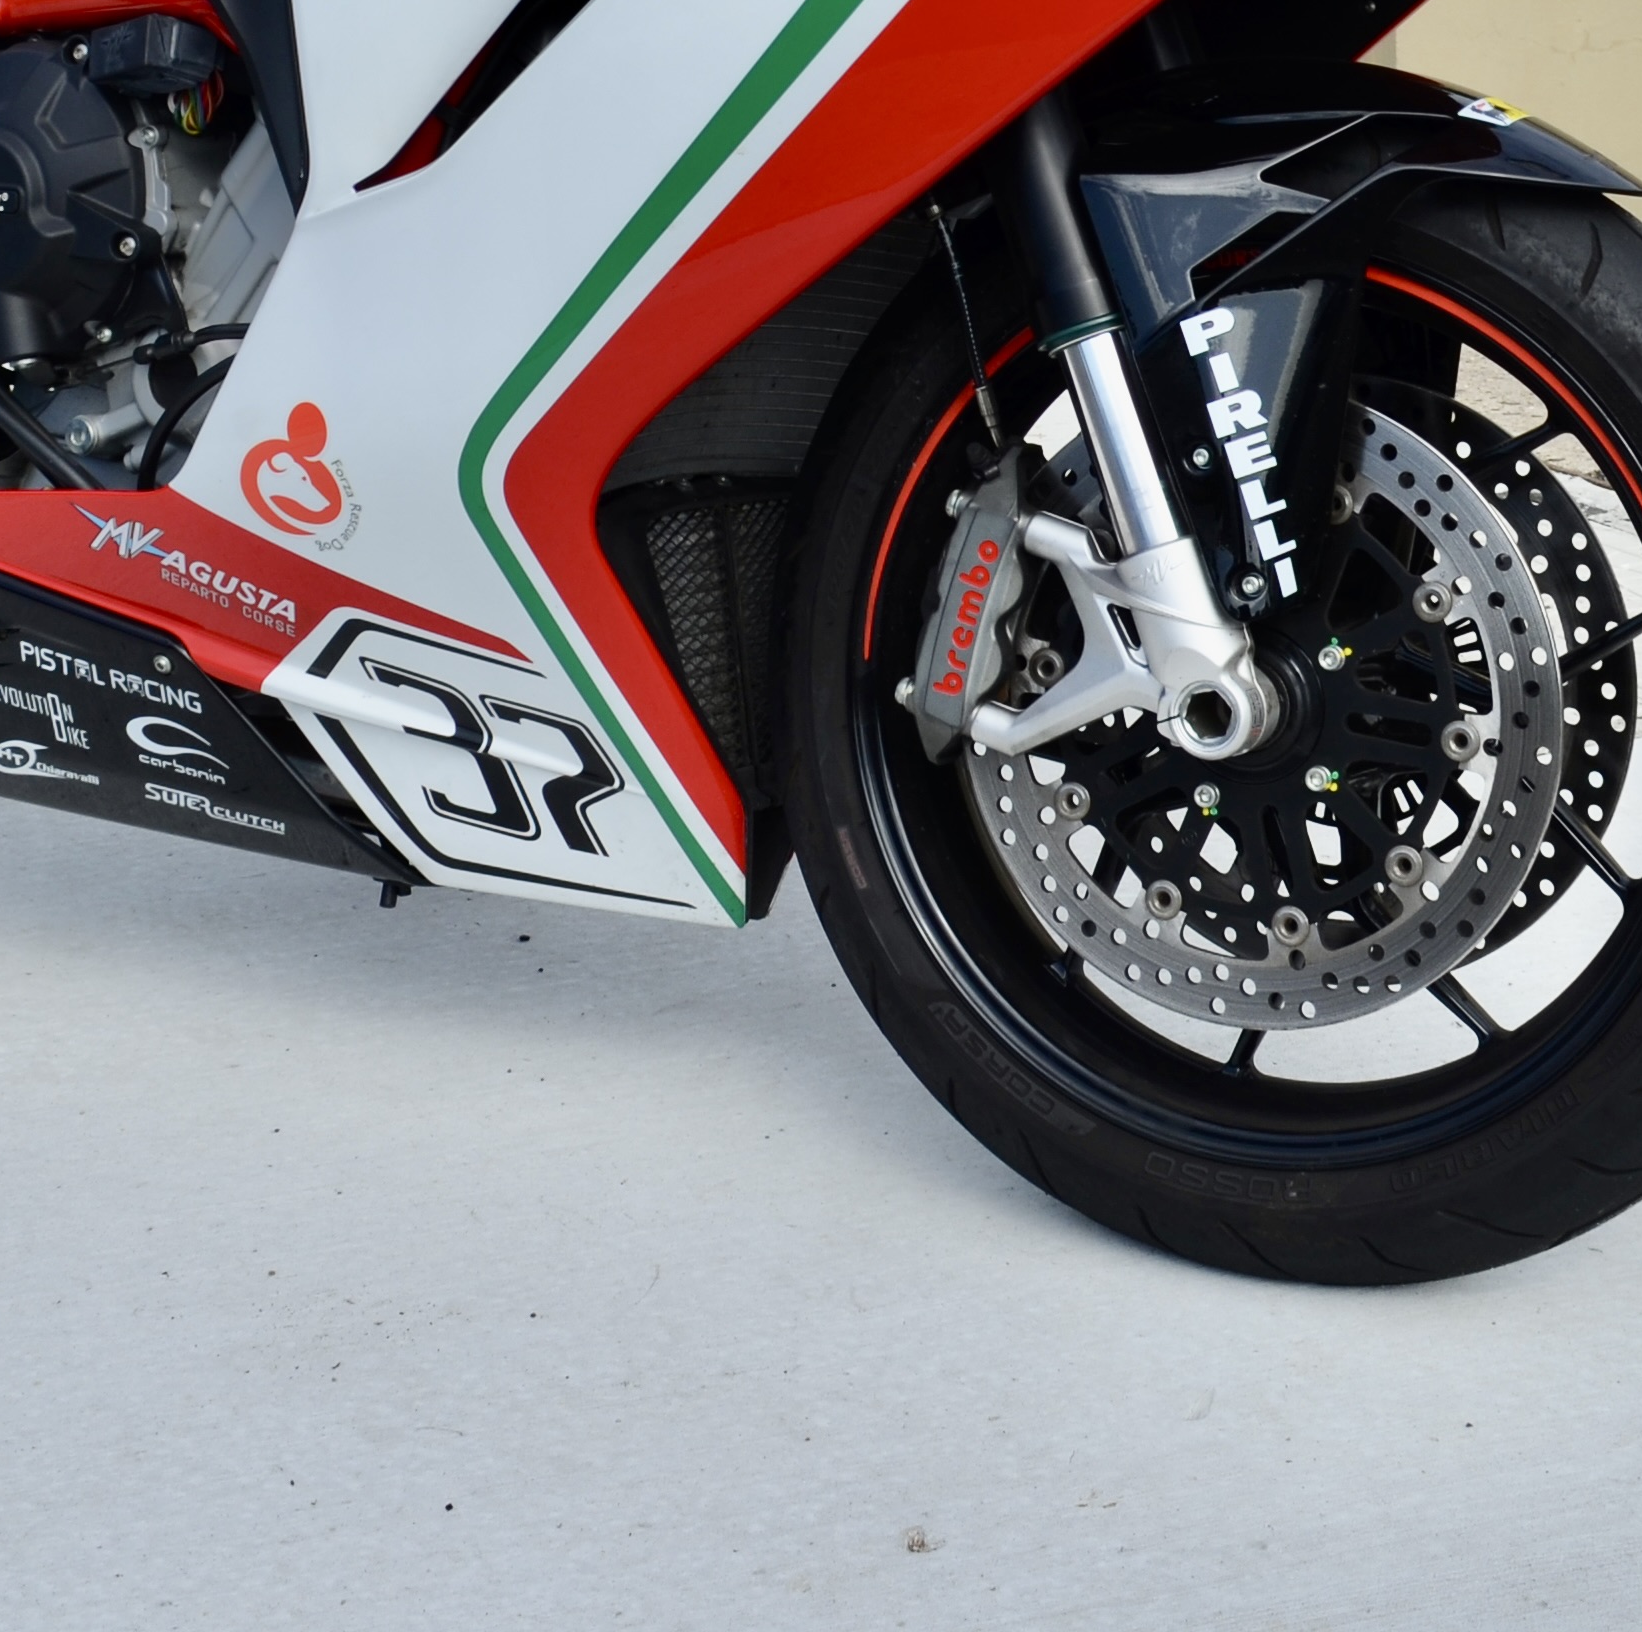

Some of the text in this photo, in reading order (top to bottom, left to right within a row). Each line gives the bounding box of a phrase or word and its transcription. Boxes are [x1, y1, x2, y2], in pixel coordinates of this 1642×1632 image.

[1180, 307, 1298, 598] PIRELLI
[315, 459, 362, 551] Forza Rescue Dog
[90, 518, 296, 623] MV AGUSTA
[161, 567, 296, 637] REPARTO CORSE
[933, 539, 999, 696] brembo
[109, 669, 202, 714] RACING
[35, 761, 100, 785] Chiaravalli
[139, 754, 227, 785] carbonin
